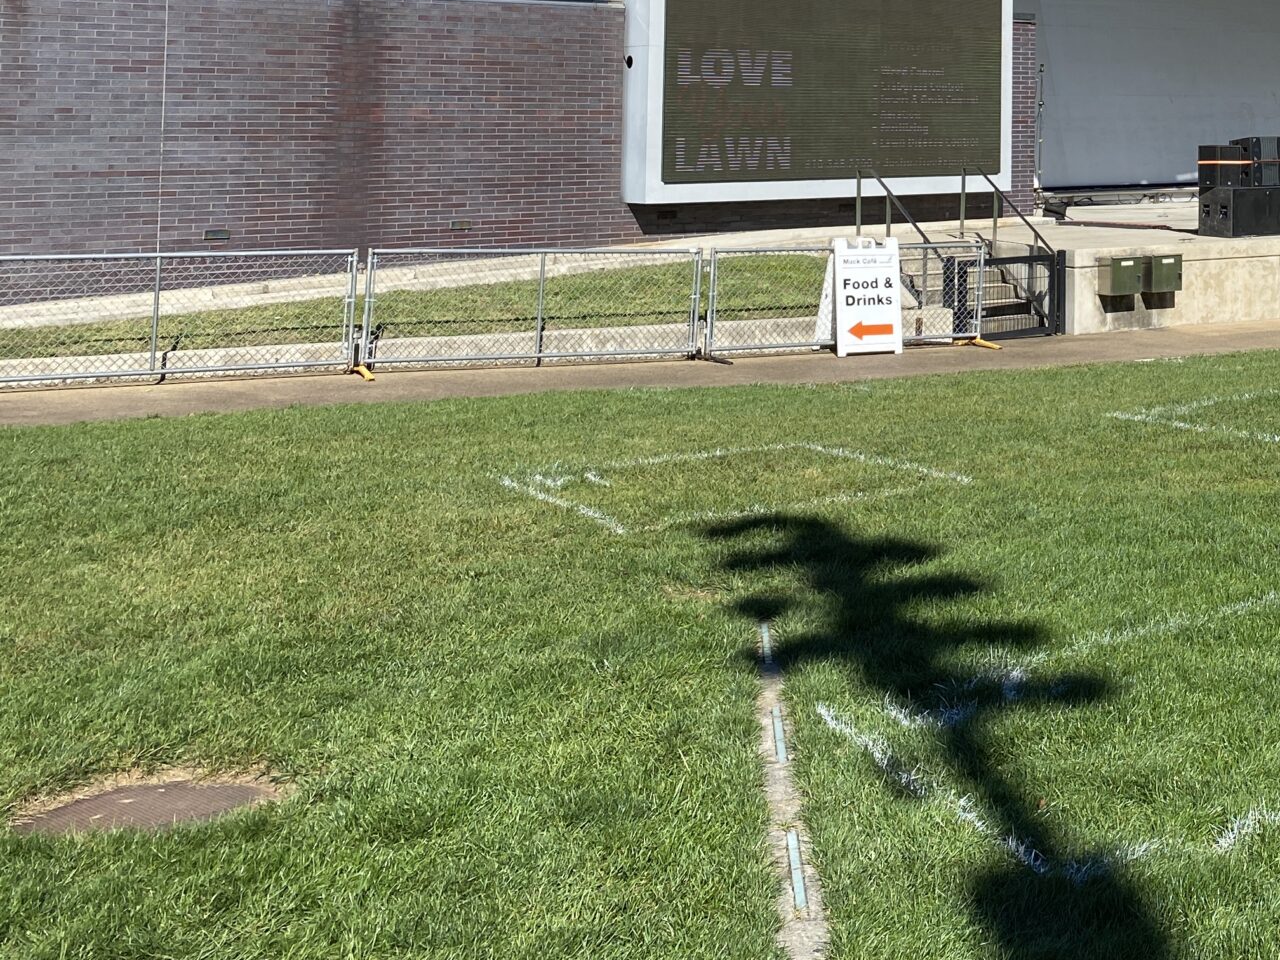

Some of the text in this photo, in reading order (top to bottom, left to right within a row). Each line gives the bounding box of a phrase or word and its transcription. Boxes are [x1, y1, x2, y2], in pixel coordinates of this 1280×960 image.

[676, 48, 794, 89] LOVE
[675, 137, 792, 173] LAWN
[843, 277, 894, 290] Food &
[845, 294, 893, 307] Drinks
